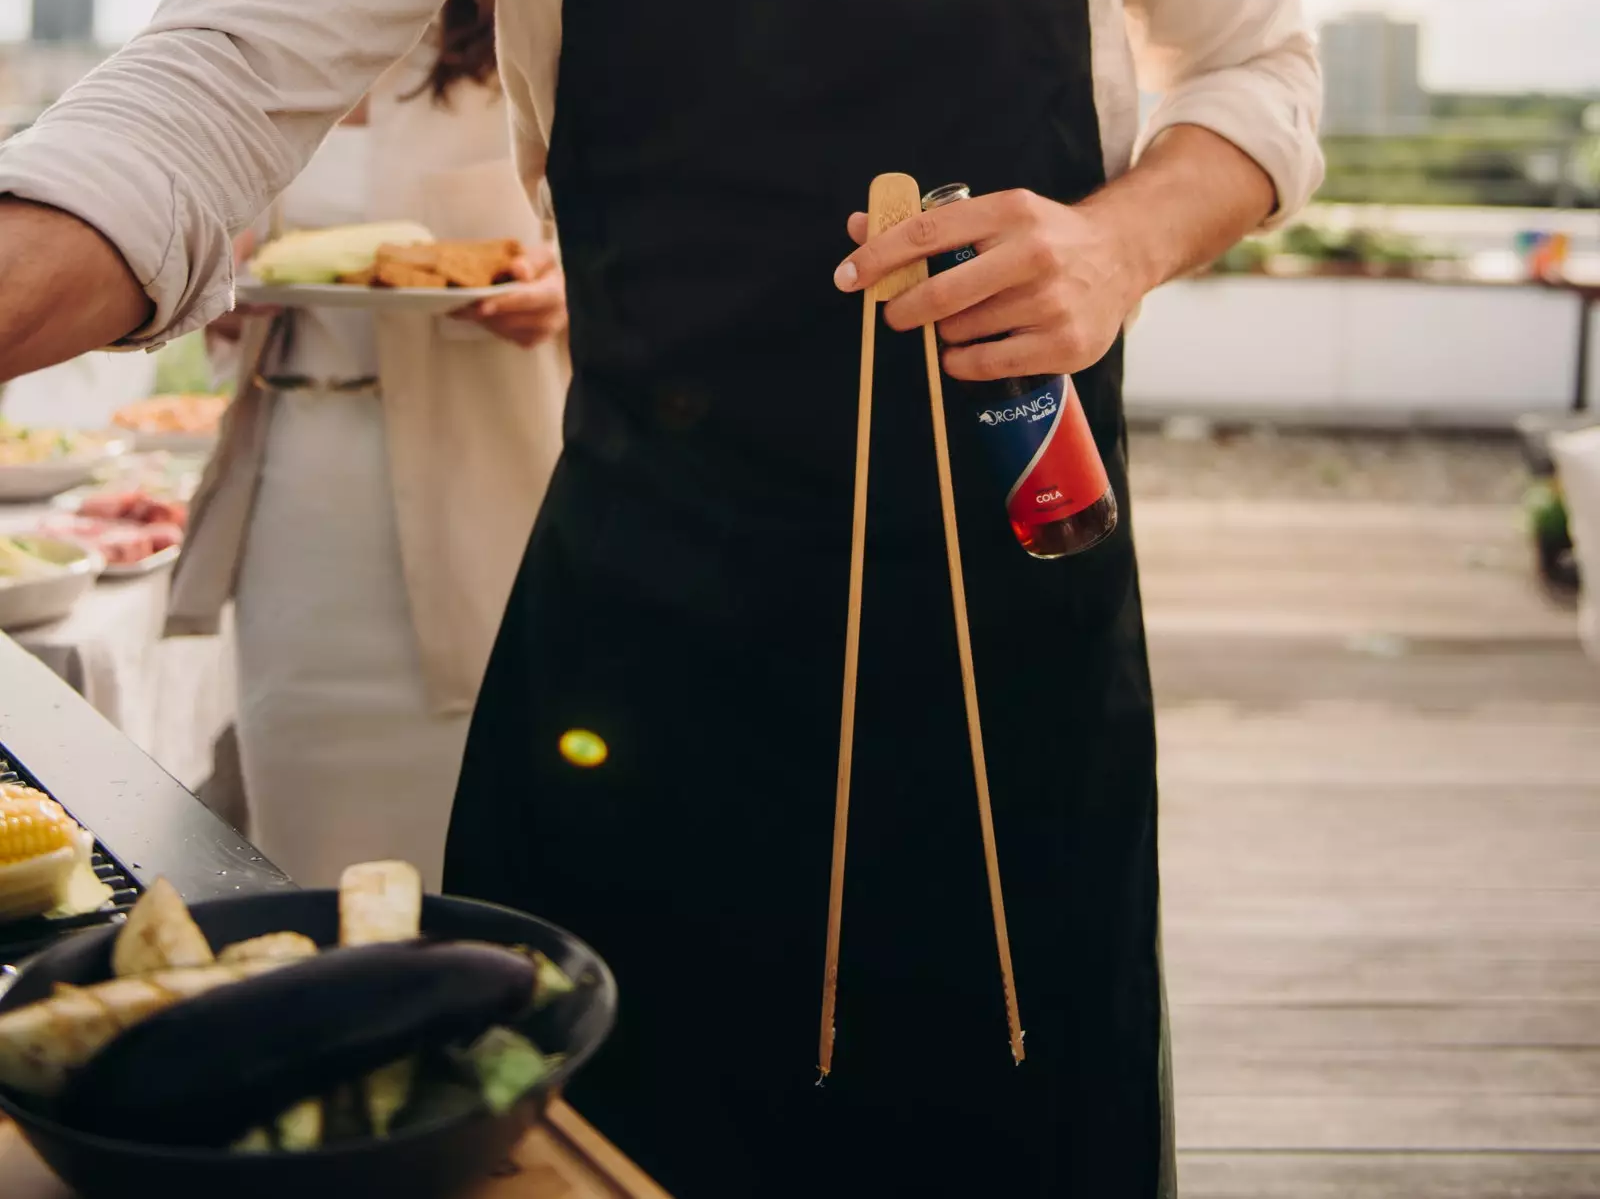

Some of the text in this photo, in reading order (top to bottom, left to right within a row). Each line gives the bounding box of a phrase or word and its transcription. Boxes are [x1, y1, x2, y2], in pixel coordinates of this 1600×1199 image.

[955, 249, 976, 261] COL
[983, 392, 1054, 426] ORGANICS
[1036, 490, 1063, 504] COLA
